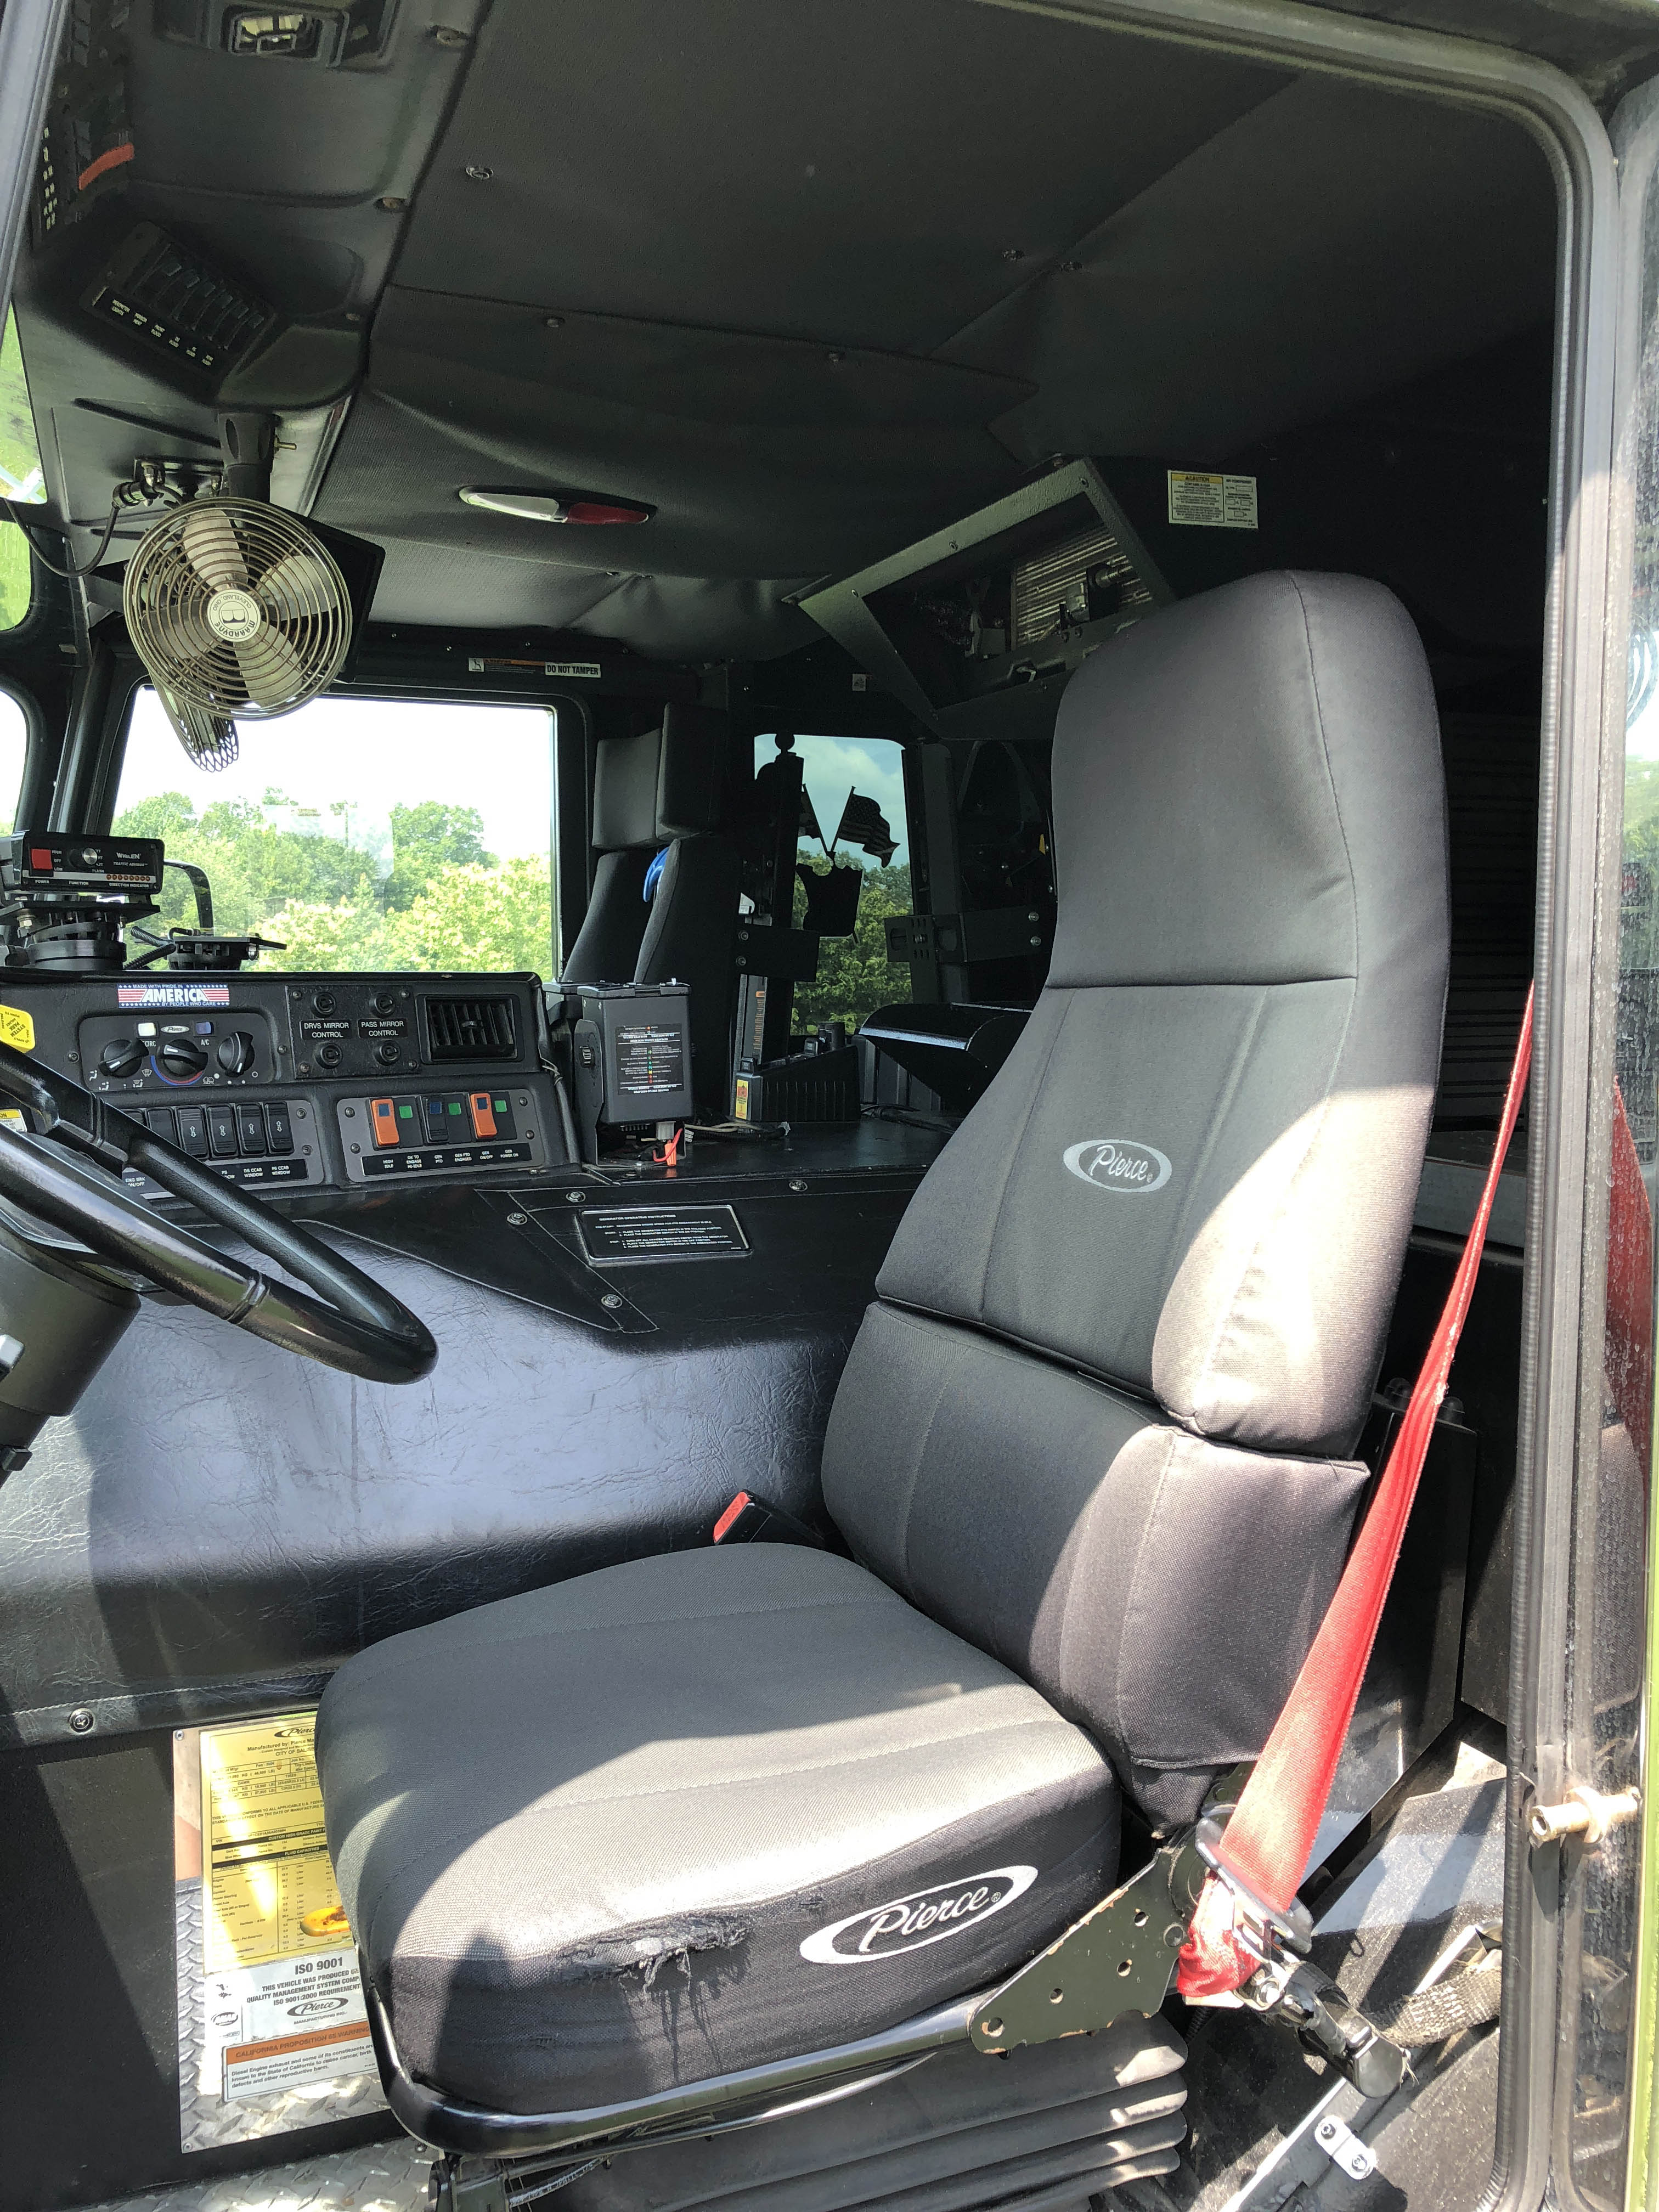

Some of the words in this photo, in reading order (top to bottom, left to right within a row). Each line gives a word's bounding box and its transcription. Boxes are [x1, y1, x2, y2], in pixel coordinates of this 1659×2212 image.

[213, 600, 222, 611] OHIO
[548, 664, 556, 673] DO
[558, 665, 571, 674] NOT
[572, 665, 599, 675] TAMPER
[141, 989, 210, 1002] AMERICA
[9, 1021, 20, 1031] PARK
[10, 1024, 26, 1037] SYSTEM
[1088, 1144, 1149, 1181] Pierce
[287, 1728, 315, 1736] Pierc
[247, 1742, 281, 1751] Manufactured
[858, 1887, 991, 1952] Pierce
[295, 1962, 313, 1975] ISO
[317, 1956, 343, 1971] 9001
[277, 1979, 301, 1989] VEHICLE
[318, 1971, 349, 1981] PRODUCED
[247, 1993, 271, 2003] QUALITY
[273, 1984, 314, 1998] MANAGEMENT
[317, 1980, 340, 1989] SYSTEM
[342, 1976, 359, 1984] COMP
[285, 1992, 317, 2004] 9001:2000
[319, 1983, 360, 1997] REQUIREMENT
[301, 2001, 334, 2015] Pierce
[294, 2013, 335, 2025] MANUFACTURING
[236, 2045, 278, 2057] CALIFORNIA
[280, 2034, 326, 2049] PROPOSITION
[338, 2027, 369, 2038] WARNING
[332, 2045, 364, 2055] constituents
[289, 2061, 315, 2070] California
[279, 2068, 312, 2079] reproductive
